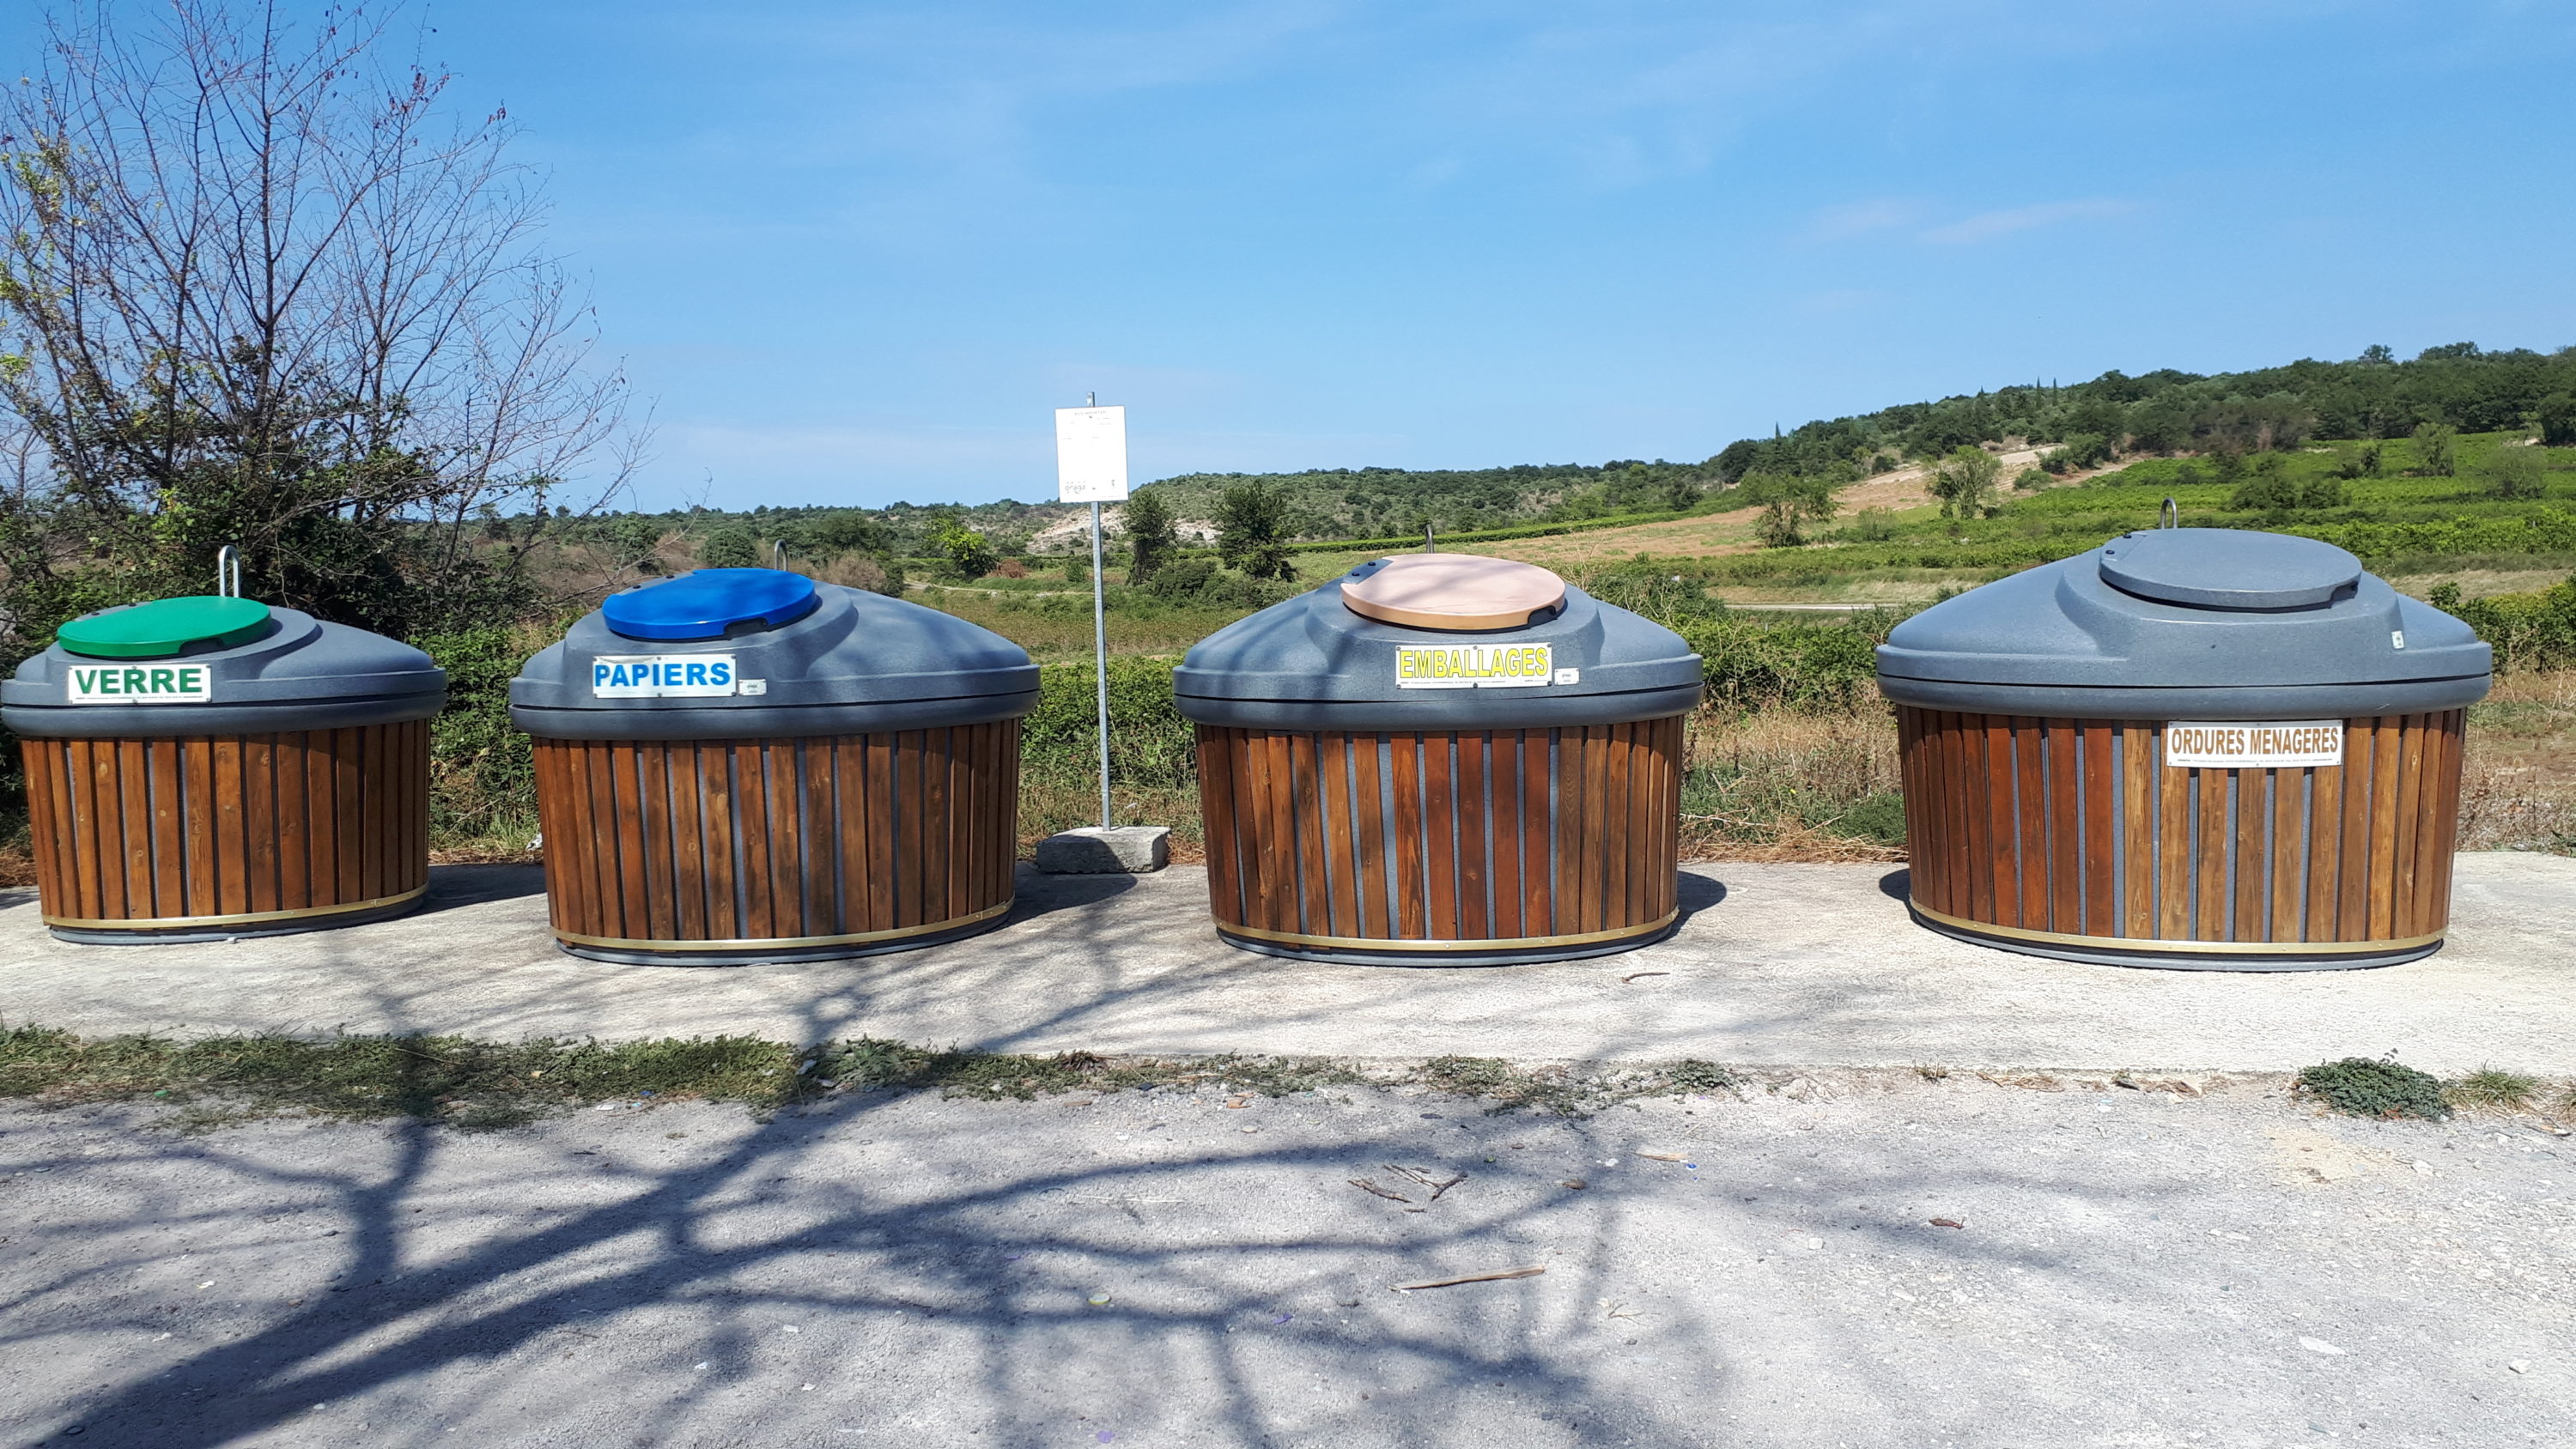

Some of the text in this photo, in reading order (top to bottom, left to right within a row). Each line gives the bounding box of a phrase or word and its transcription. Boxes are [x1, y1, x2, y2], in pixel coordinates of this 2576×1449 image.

[595, 663, 731, 687] PAPIERS
[1400, 647, 1549, 678] EMBALLAGES
[75, 669, 203, 694] VERRE
[2172, 727, 2338, 755] ORDURES MENAGERES
